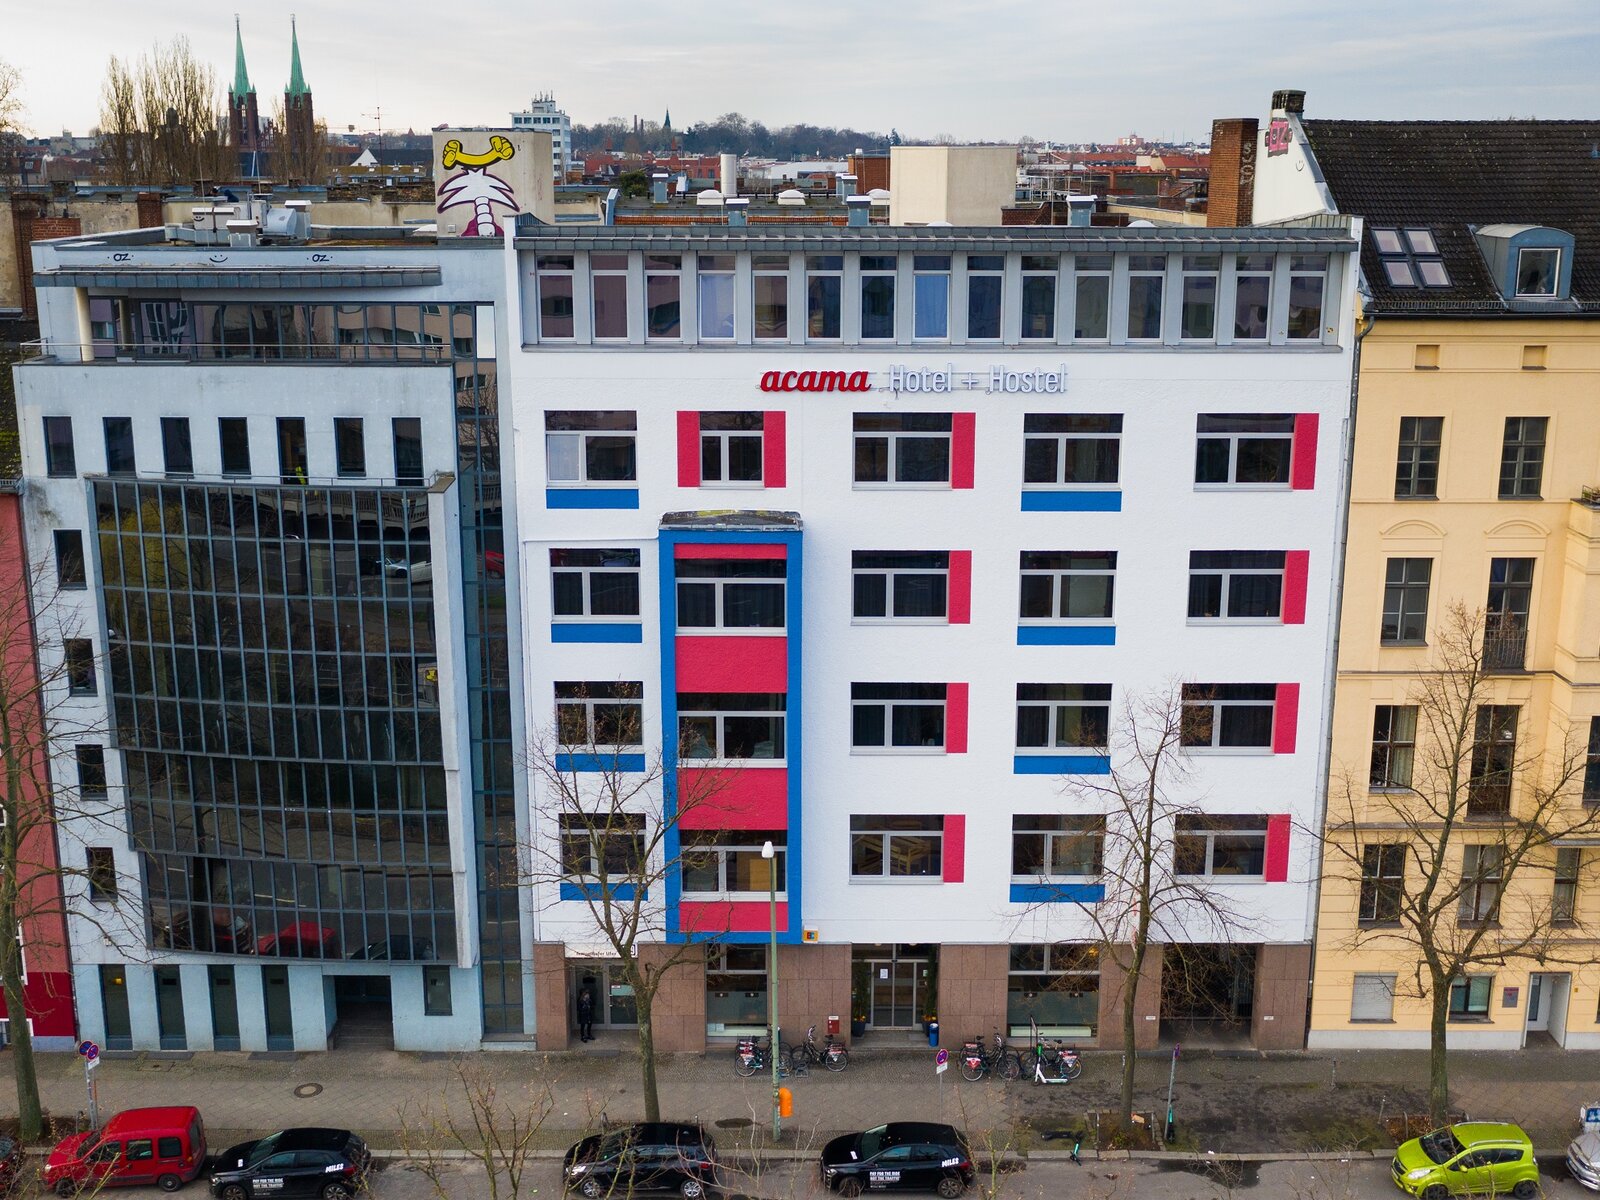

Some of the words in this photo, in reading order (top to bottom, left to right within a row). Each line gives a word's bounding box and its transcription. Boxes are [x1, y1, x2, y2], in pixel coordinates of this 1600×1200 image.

[760, 370, 872, 393] acama
[889, 363, 952, 393] Hotel
[961, 372, 979, 390] +
[989, 363, 1066, 393] Hostel
[941, 1157, 959, 1167] MILES
[325, 1163, 344, 1173] MILES
